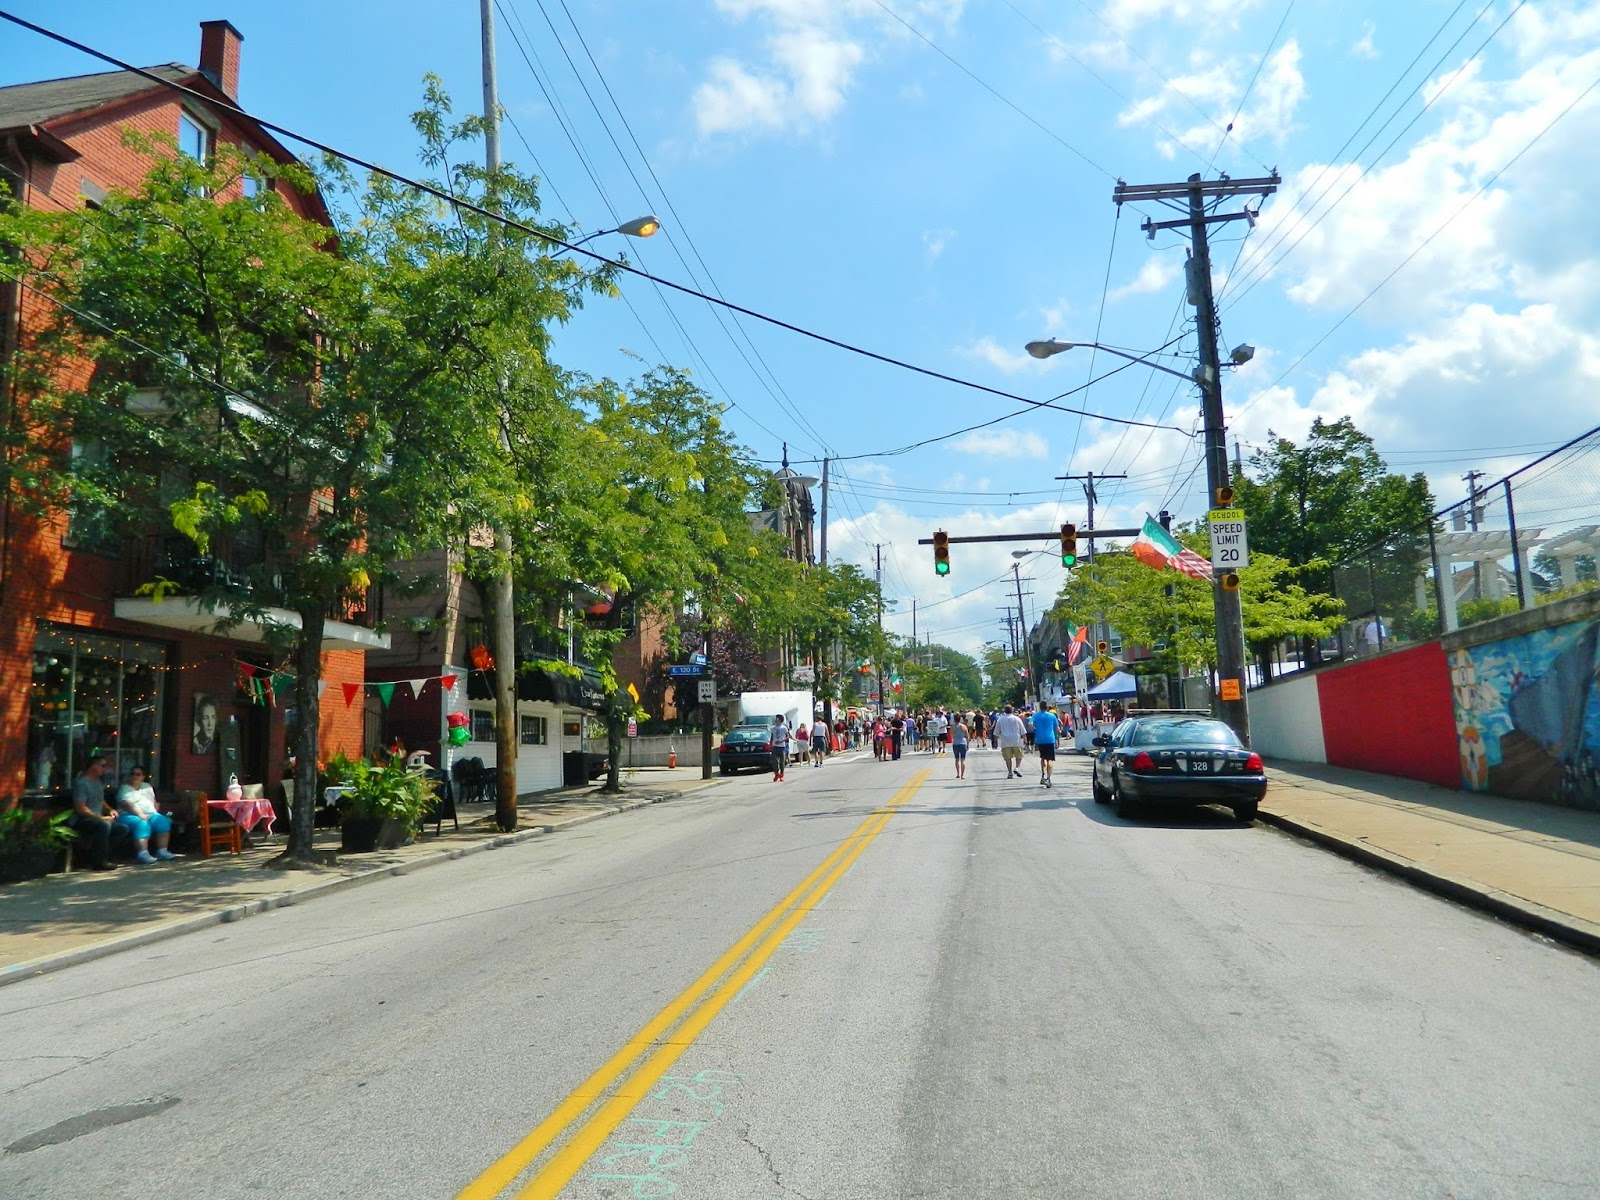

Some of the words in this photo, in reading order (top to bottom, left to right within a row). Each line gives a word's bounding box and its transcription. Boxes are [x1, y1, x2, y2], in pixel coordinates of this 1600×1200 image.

[1213, 523, 1242, 533] SPEED
[1216, 535, 1239, 544] LIMIT
[1220, 549, 1239, 561] 20
[1192, 762, 1208, 771] 328
